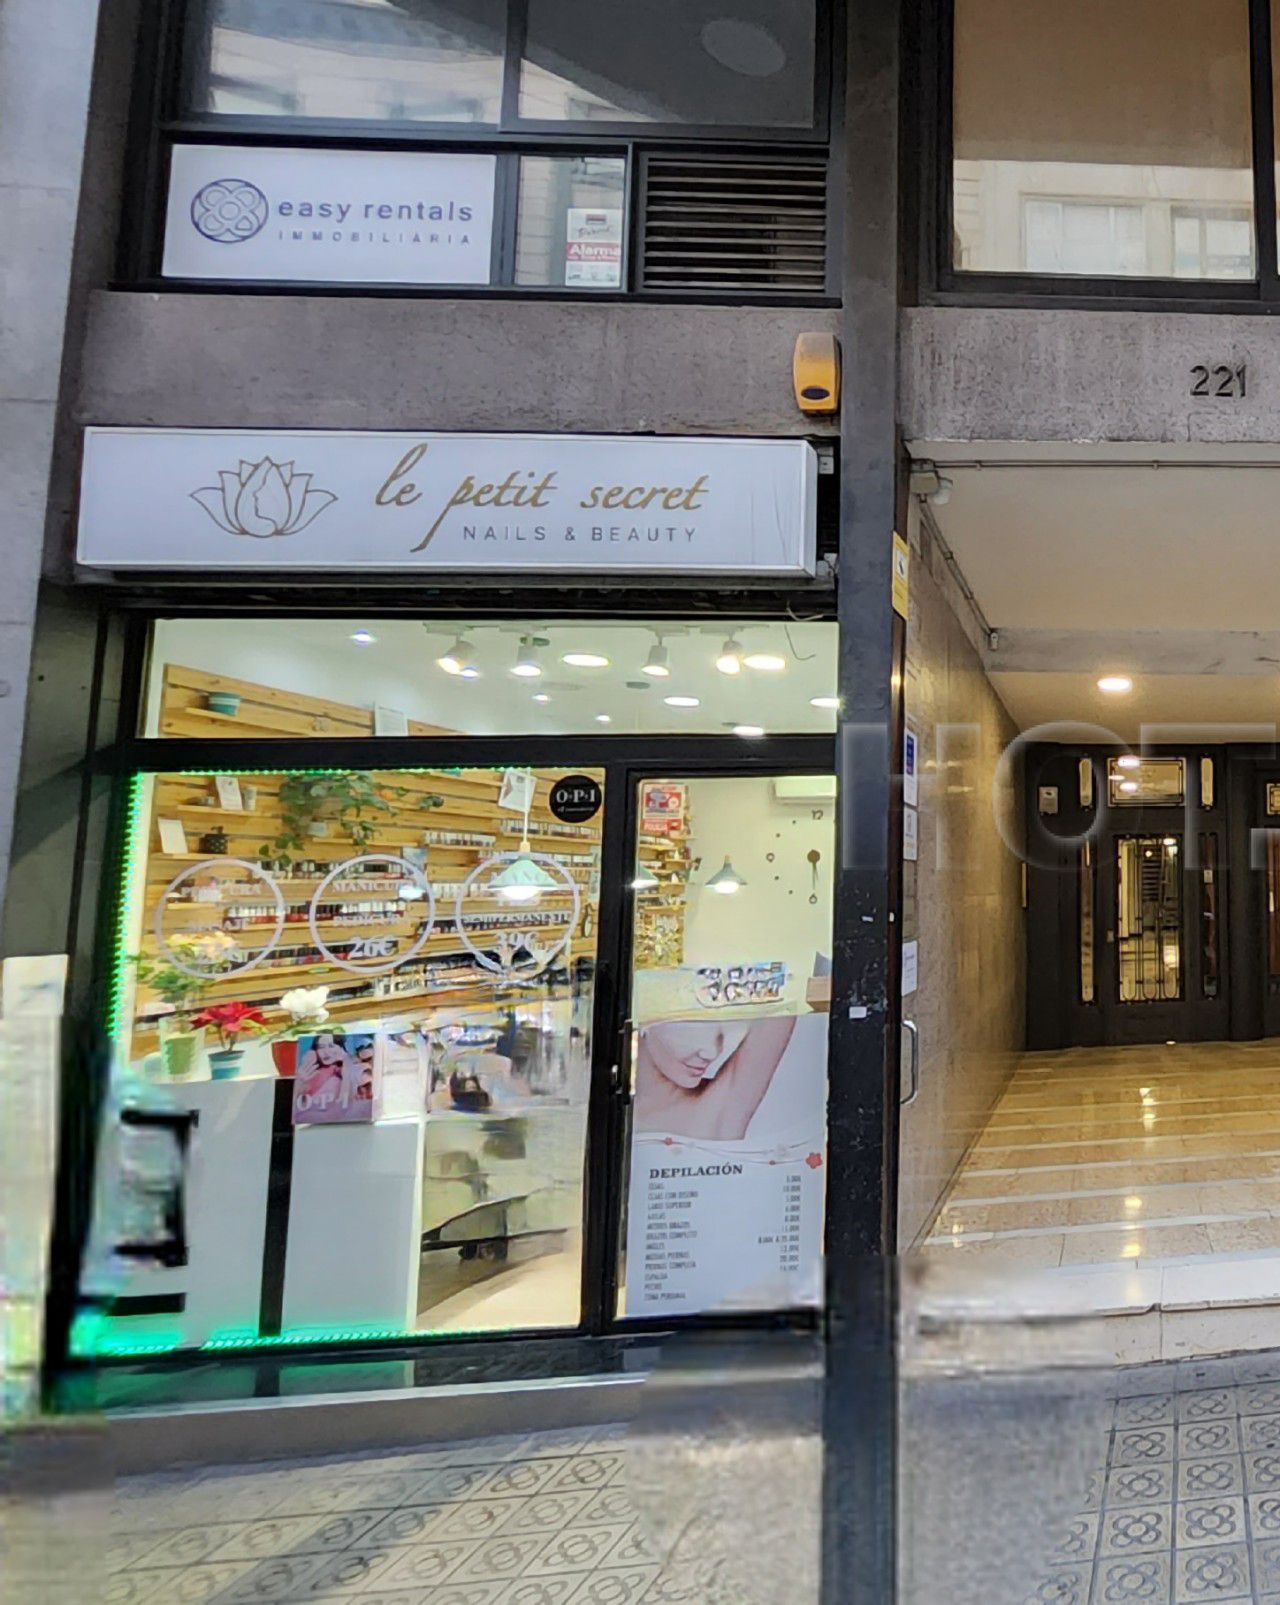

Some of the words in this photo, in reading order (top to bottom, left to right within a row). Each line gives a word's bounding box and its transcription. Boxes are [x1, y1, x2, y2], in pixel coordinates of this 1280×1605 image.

[278, 201, 351, 223] easy
[364, 202, 473, 221] rentals
[278, 231, 470, 244] IMMOBILIARIA
[1190, 365, 1246, 398] 221
[375, 443, 428, 506] le
[410, 471, 558, 553] petit
[580, 475, 709, 511] secret
[463, 526, 546, 541] NAILS
[564, 527, 576, 541] &
[592, 527, 697, 542] BEAUTY
[649, 1162, 743, 1179] DEPILACIÓN
